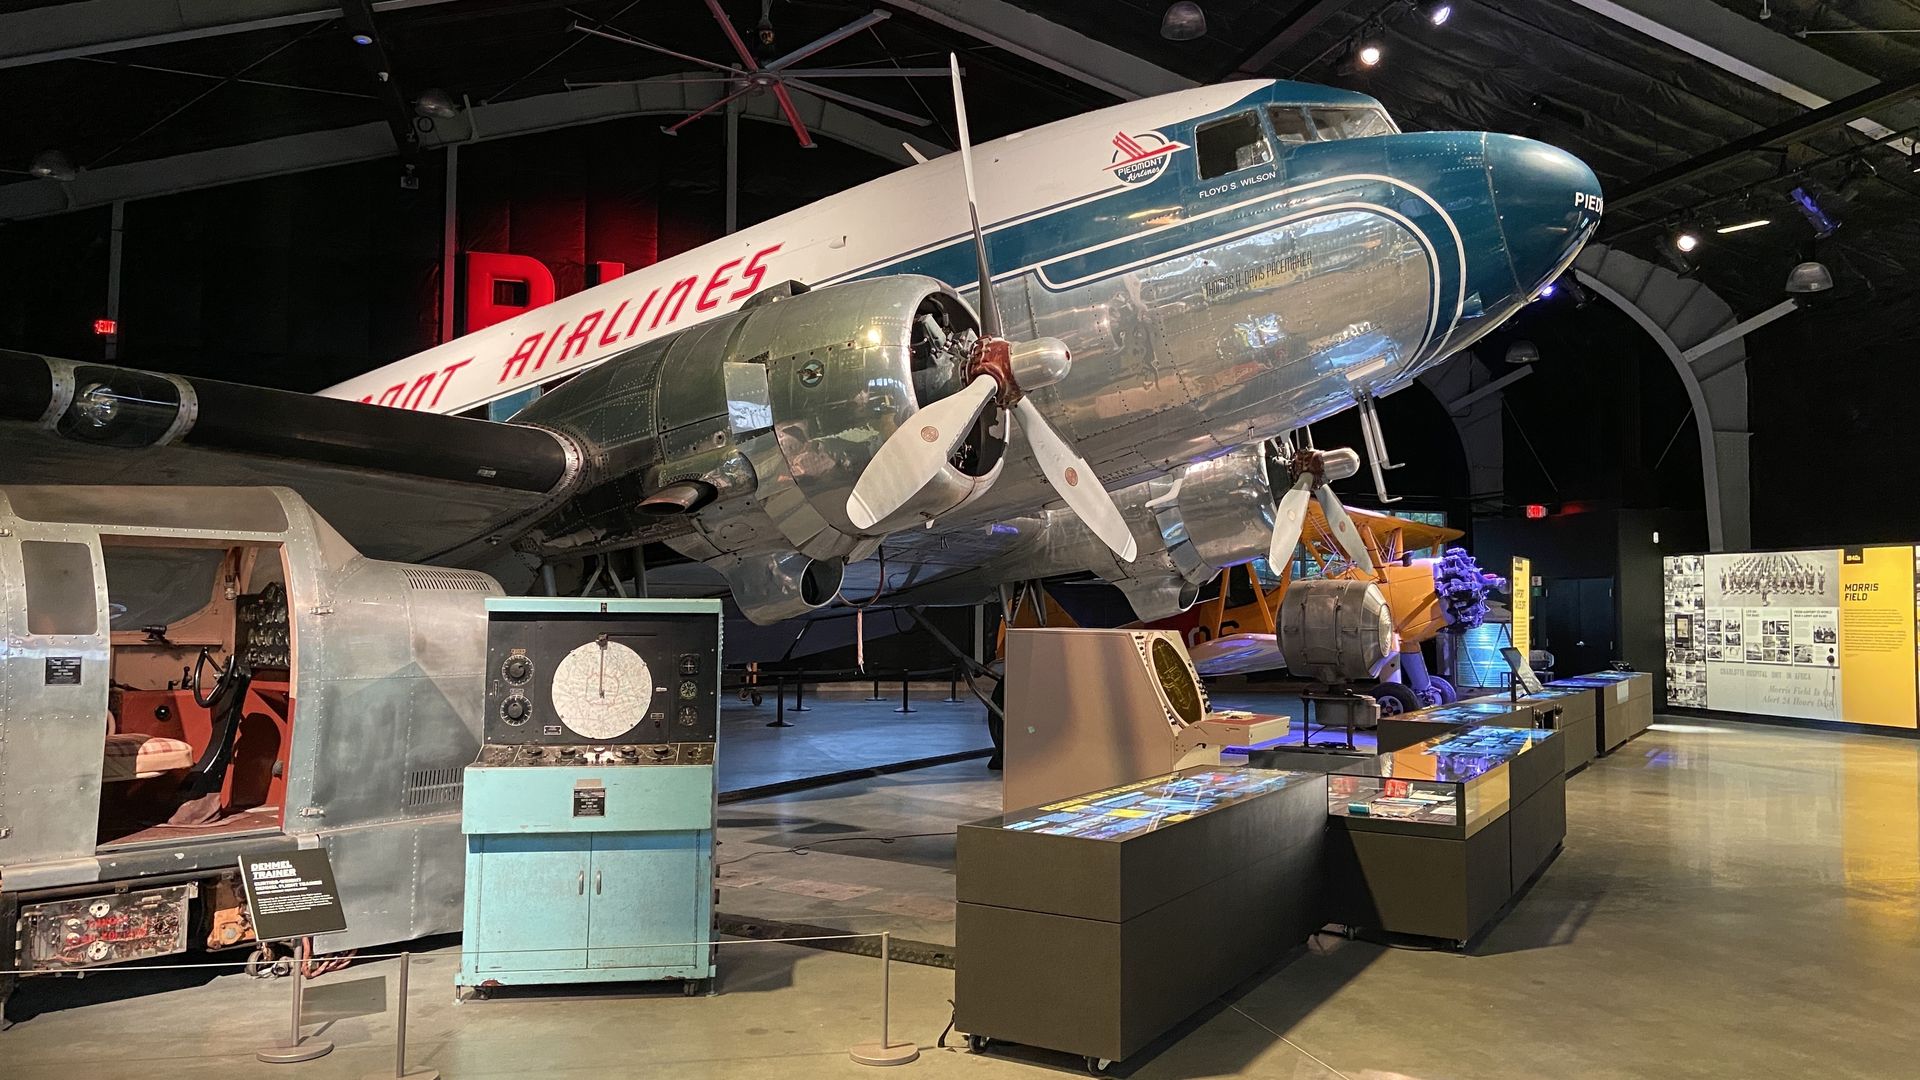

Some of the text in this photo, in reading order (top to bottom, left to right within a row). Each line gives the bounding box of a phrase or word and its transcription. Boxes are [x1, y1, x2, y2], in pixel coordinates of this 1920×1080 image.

[1117, 156, 1163, 176] PIEDMONT
[1126, 166, 1160, 183] Airlines
[1199, 184, 1229, 199] FLOYD
[1240, 171, 1276, 187] WILSON
[1574, 191, 1604, 217] PIED
[1205, 274, 1234, 297] THOMAS
[1244, 265, 1265, 285] DAVIS
[1266, 250, 1313, 277] PACEMAKER
[358, 241, 786, 411] ONT AIRLINES
[1844, 583, 1879, 592] MORRIS
[1844, 592, 1868, 601] FIELD
[1769, 684, 1791, 694] Morris
[1793, 686, 1811, 696] Field
[1761, 695, 1780, 705] Alert
[1792, 697, 1814, 707] Hours
[251, 860, 292, 871] DEHMEL
[252, 868, 297, 880] TRAINER
